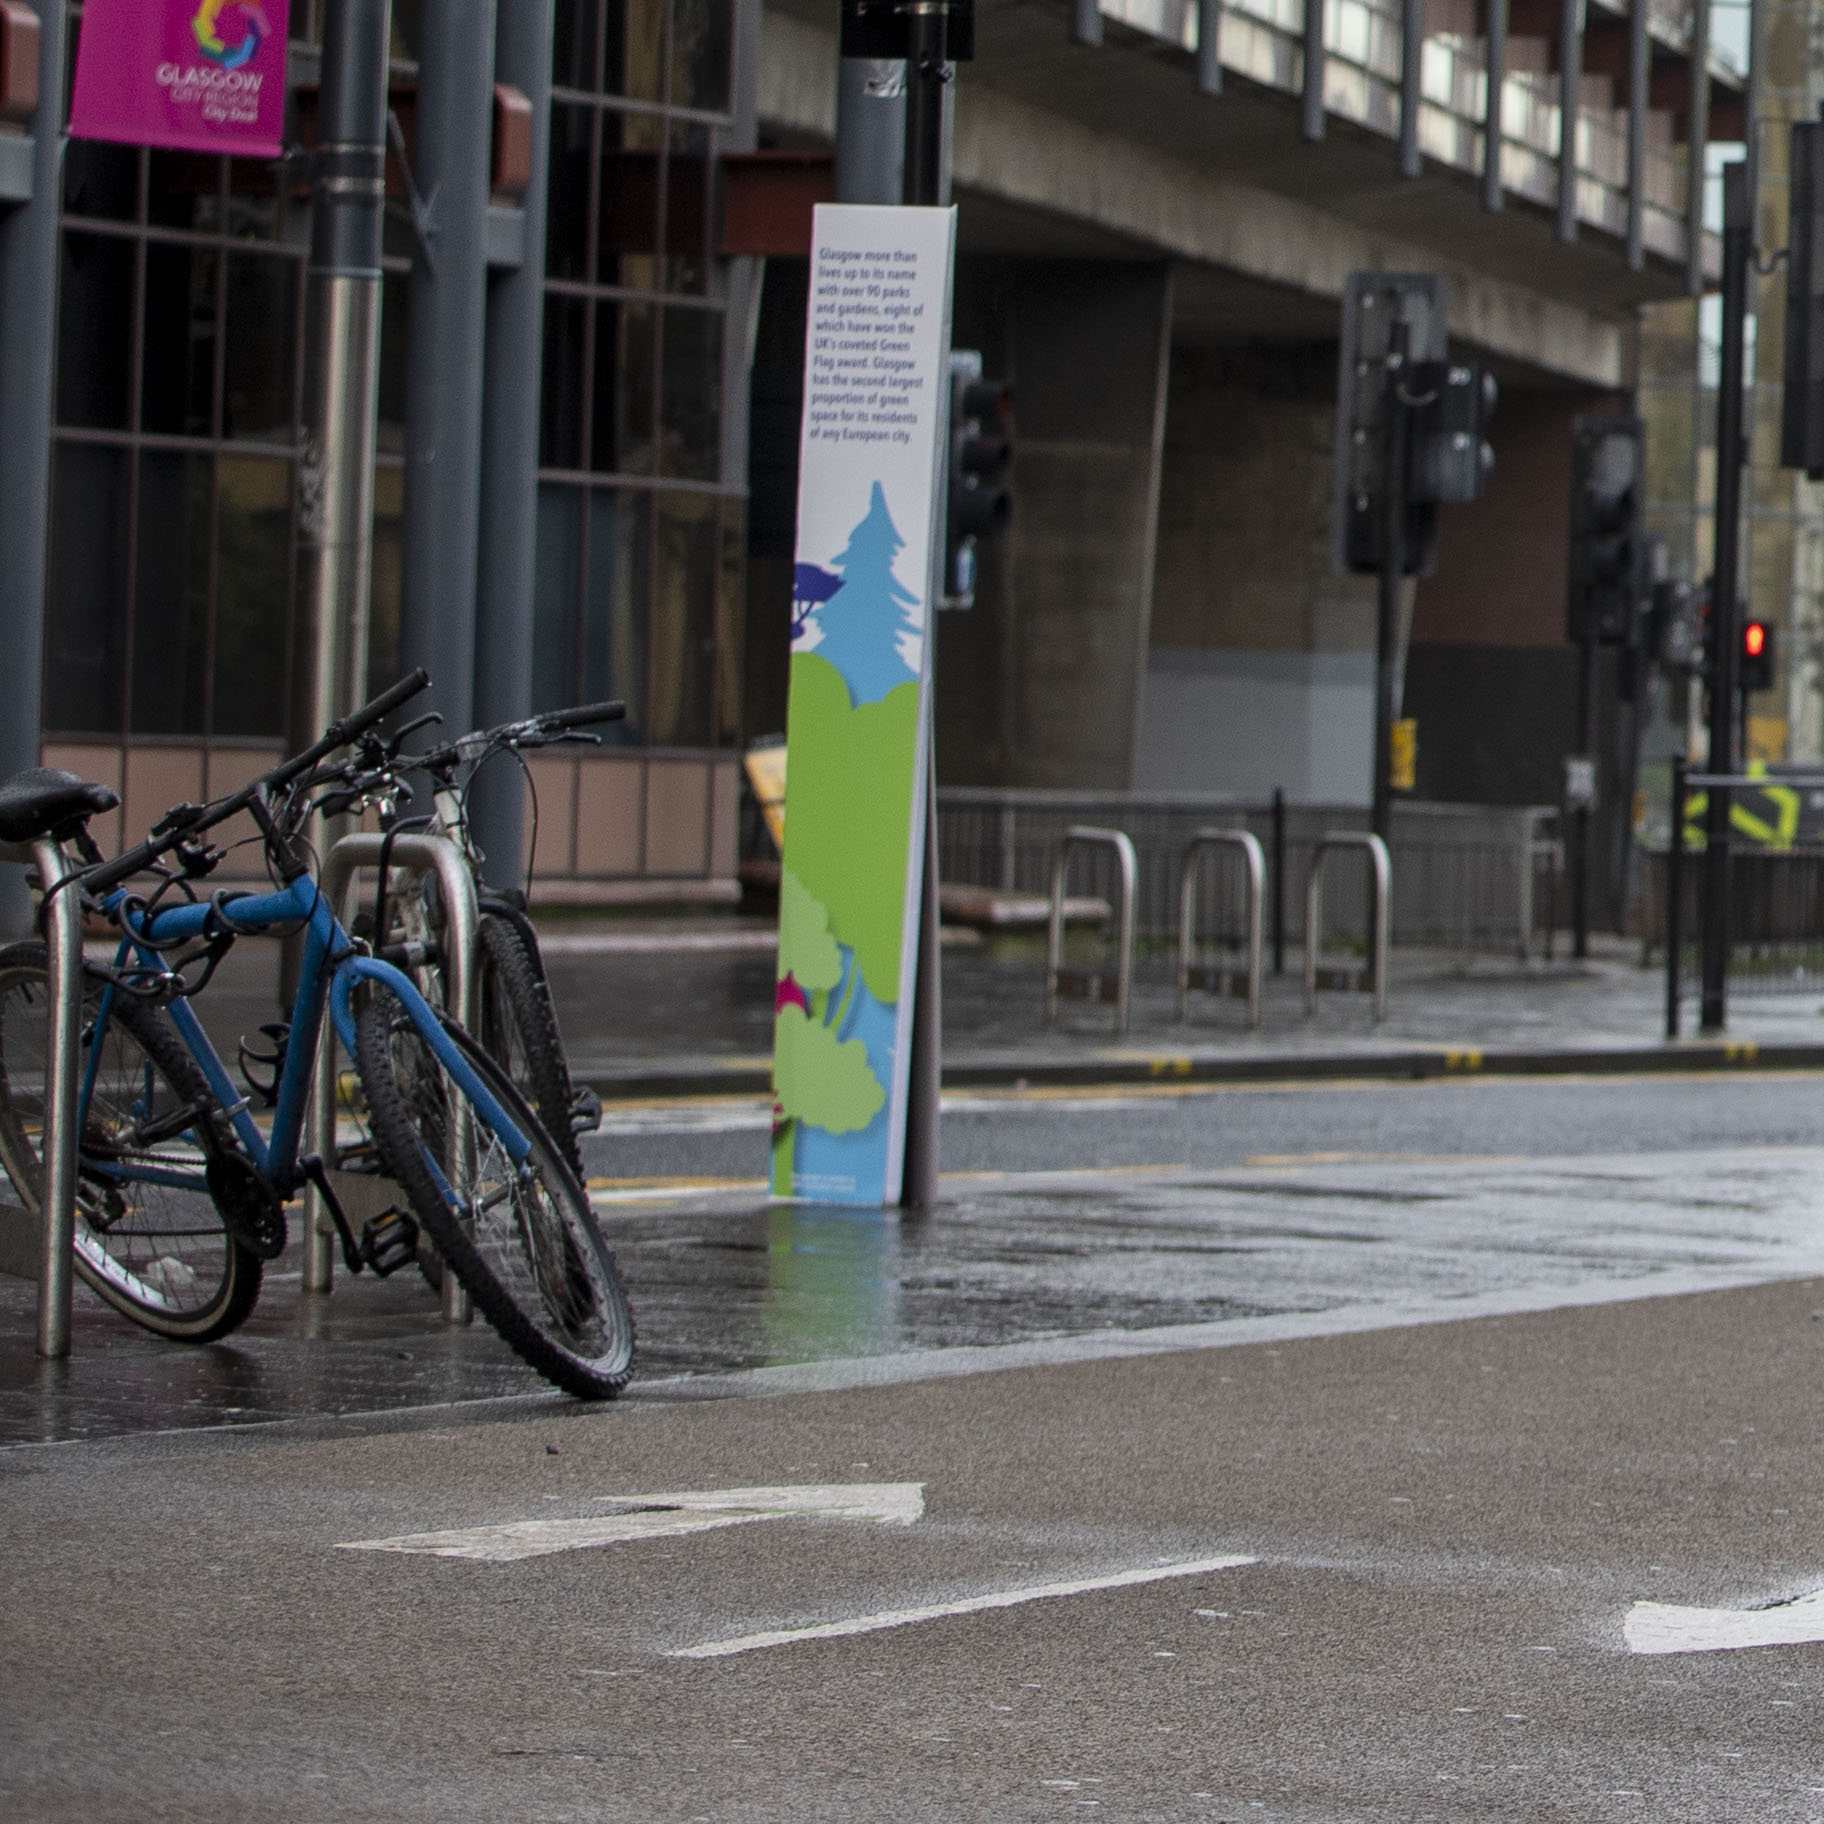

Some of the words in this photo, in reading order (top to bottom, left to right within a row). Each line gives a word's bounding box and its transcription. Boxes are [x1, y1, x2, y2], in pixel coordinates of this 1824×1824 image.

[156, 63, 263, 92] GLASGOW
[819, 248, 861, 264] Glasgow
[865, 251, 890, 261] more
[894, 250, 918, 262] than
[818, 266, 841, 278] lives
[845, 269, 857, 280] up
[860, 268, 869, 279] to
[873, 267, 885, 279] its
[888, 270, 916, 280] name
[818, 284, 837, 295] with
[842, 287, 864, 296] over
[868, 285, 880, 296] 90
[883, 287, 910, 300] parks
[817, 303, 835, 314] and
[884, 304, 911, 318] eight
[913, 304, 924, 316] of
[816, 322, 844, 331] which
[848, 321, 870, 332] have
[875, 324, 895, 332] won
[899, 322, 914, 333] the
[840, 339, 877, 351] coveted
[880, 339, 910, 351] Green
[814, 355, 834, 370] Flag
[873, 357, 916, 373] Glasgow
[813, 373, 829, 385] has
[832, 374, 847, 385] the
[851, 376, 886, 386] second
[889, 376, 923, 391] largest
[812, 392, 864, 405] proportion
[868, 392, 878, 404] of
[880, 396, 909, 408] green
[811, 411, 837, 423] space
[841, 409, 854, 421] for
[858, 411, 868, 421] its
[872, 412, 918, 423] residents
[810, 427, 820, 439] of
[822, 430, 839, 442] any
[843, 428, 890, 442] European
